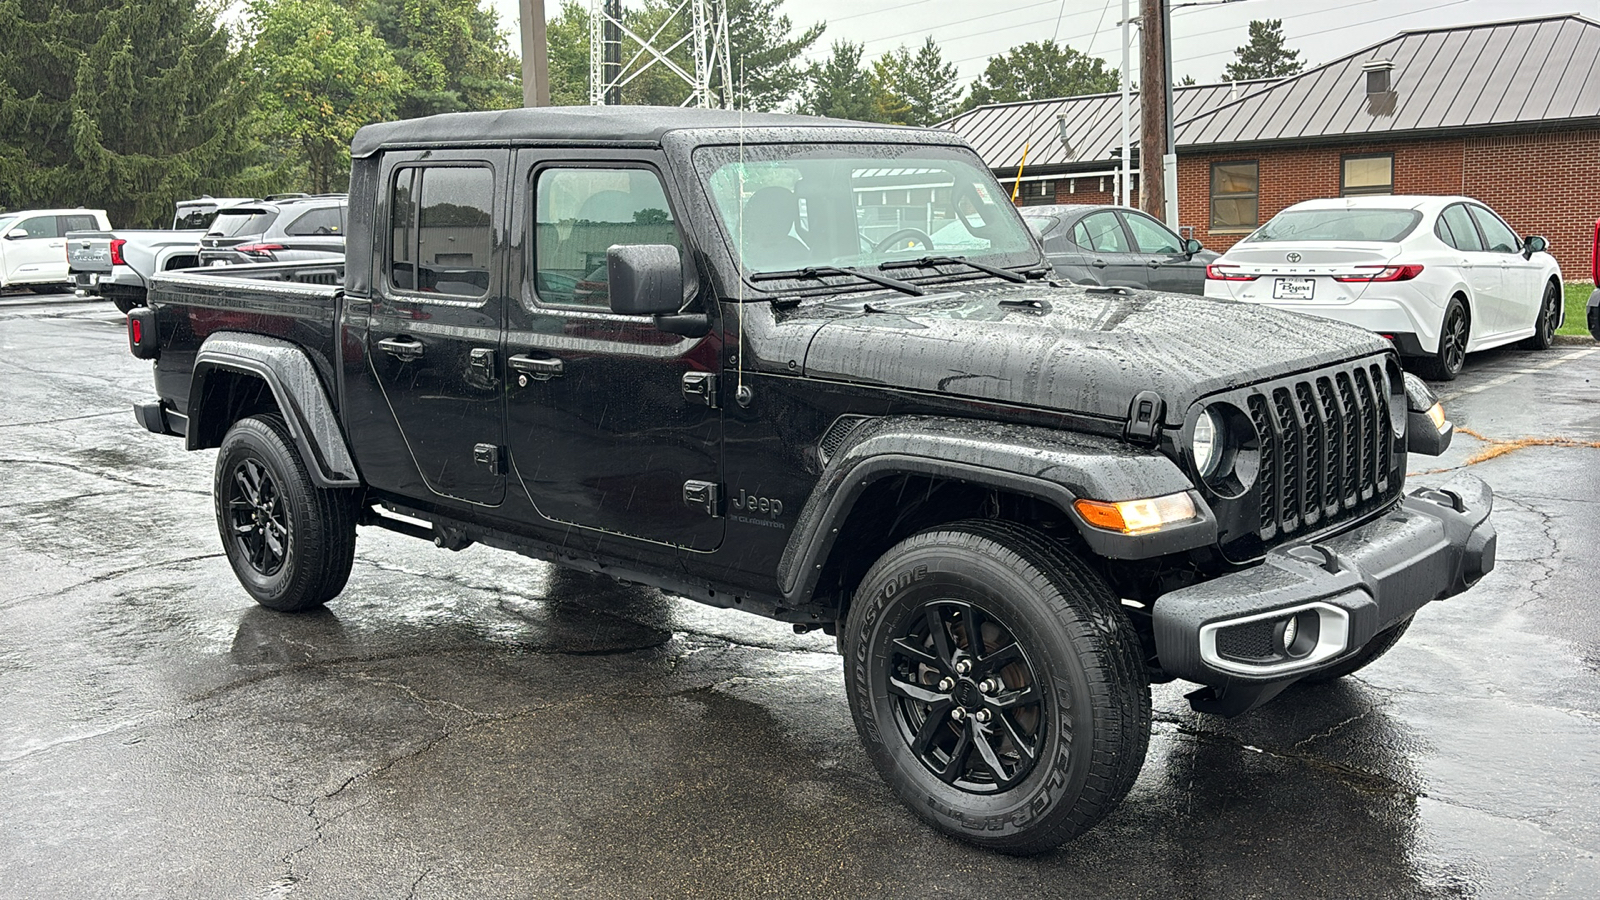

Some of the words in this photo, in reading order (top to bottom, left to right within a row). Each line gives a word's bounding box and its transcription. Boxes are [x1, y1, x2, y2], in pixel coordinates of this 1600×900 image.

[732, 488, 783, 519] Jeep
[738, 516, 785, 530] GLADIATOR
[857, 564, 929, 745] BRIDGESTONE
[1010, 674, 1074, 829] DUELER
